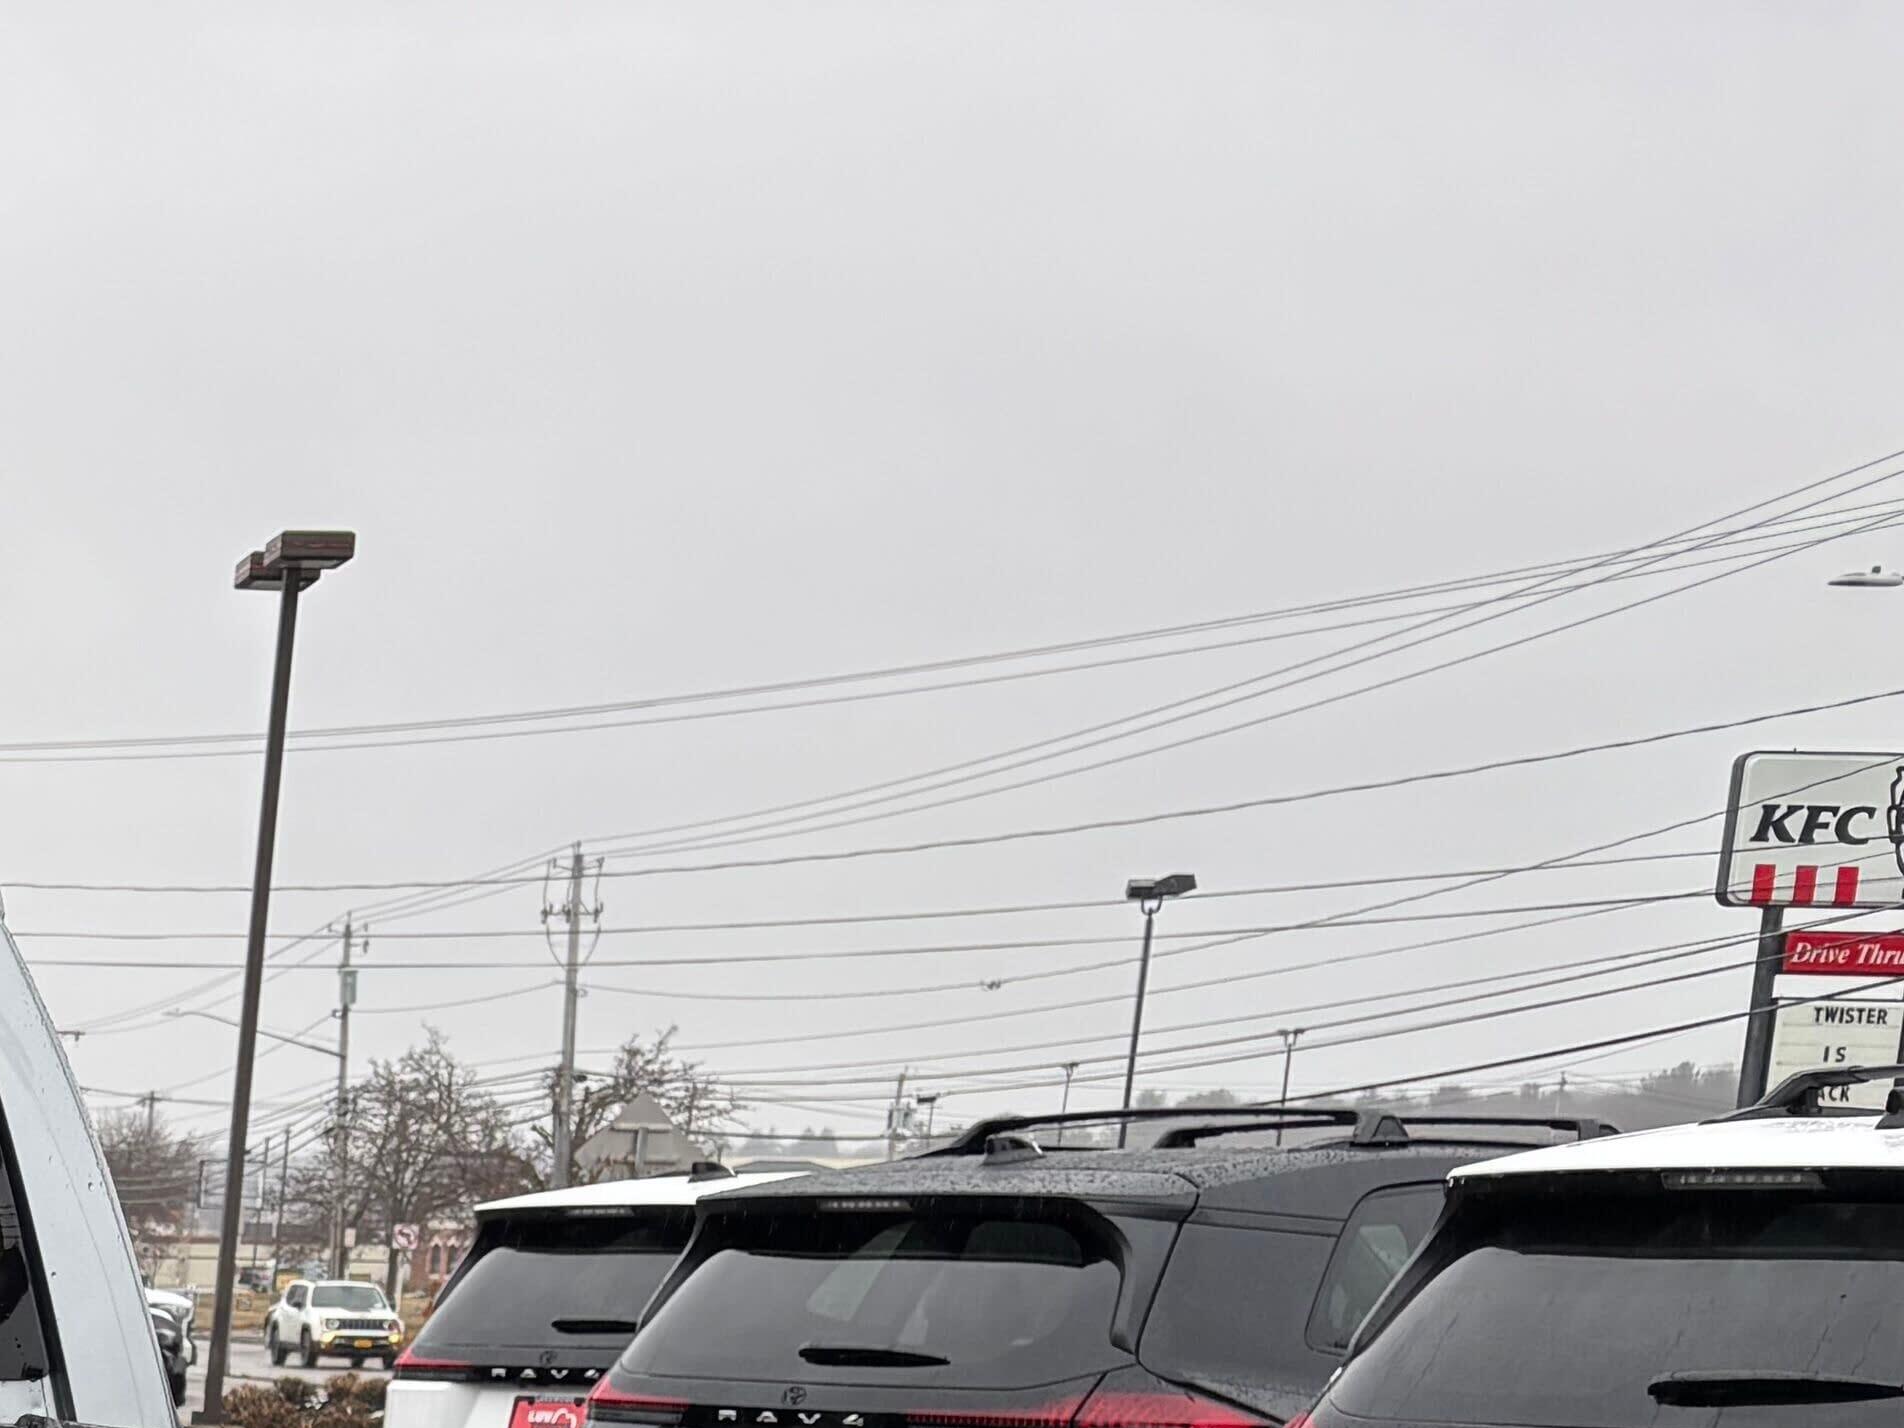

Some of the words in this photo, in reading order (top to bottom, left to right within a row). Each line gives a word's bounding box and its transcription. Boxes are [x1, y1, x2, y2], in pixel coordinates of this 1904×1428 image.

[1749, 804, 1877, 845] KFC
[1790, 942, 1851, 964] Drive
[1855, 943, 1904, 966] Thru
[1814, 1005, 1889, 1025] TWISTER
[1823, 1046, 1847, 1063] IS
[491, 1367, 600, 1380] RAV4
[718, 1409, 865, 1427] RAV4
